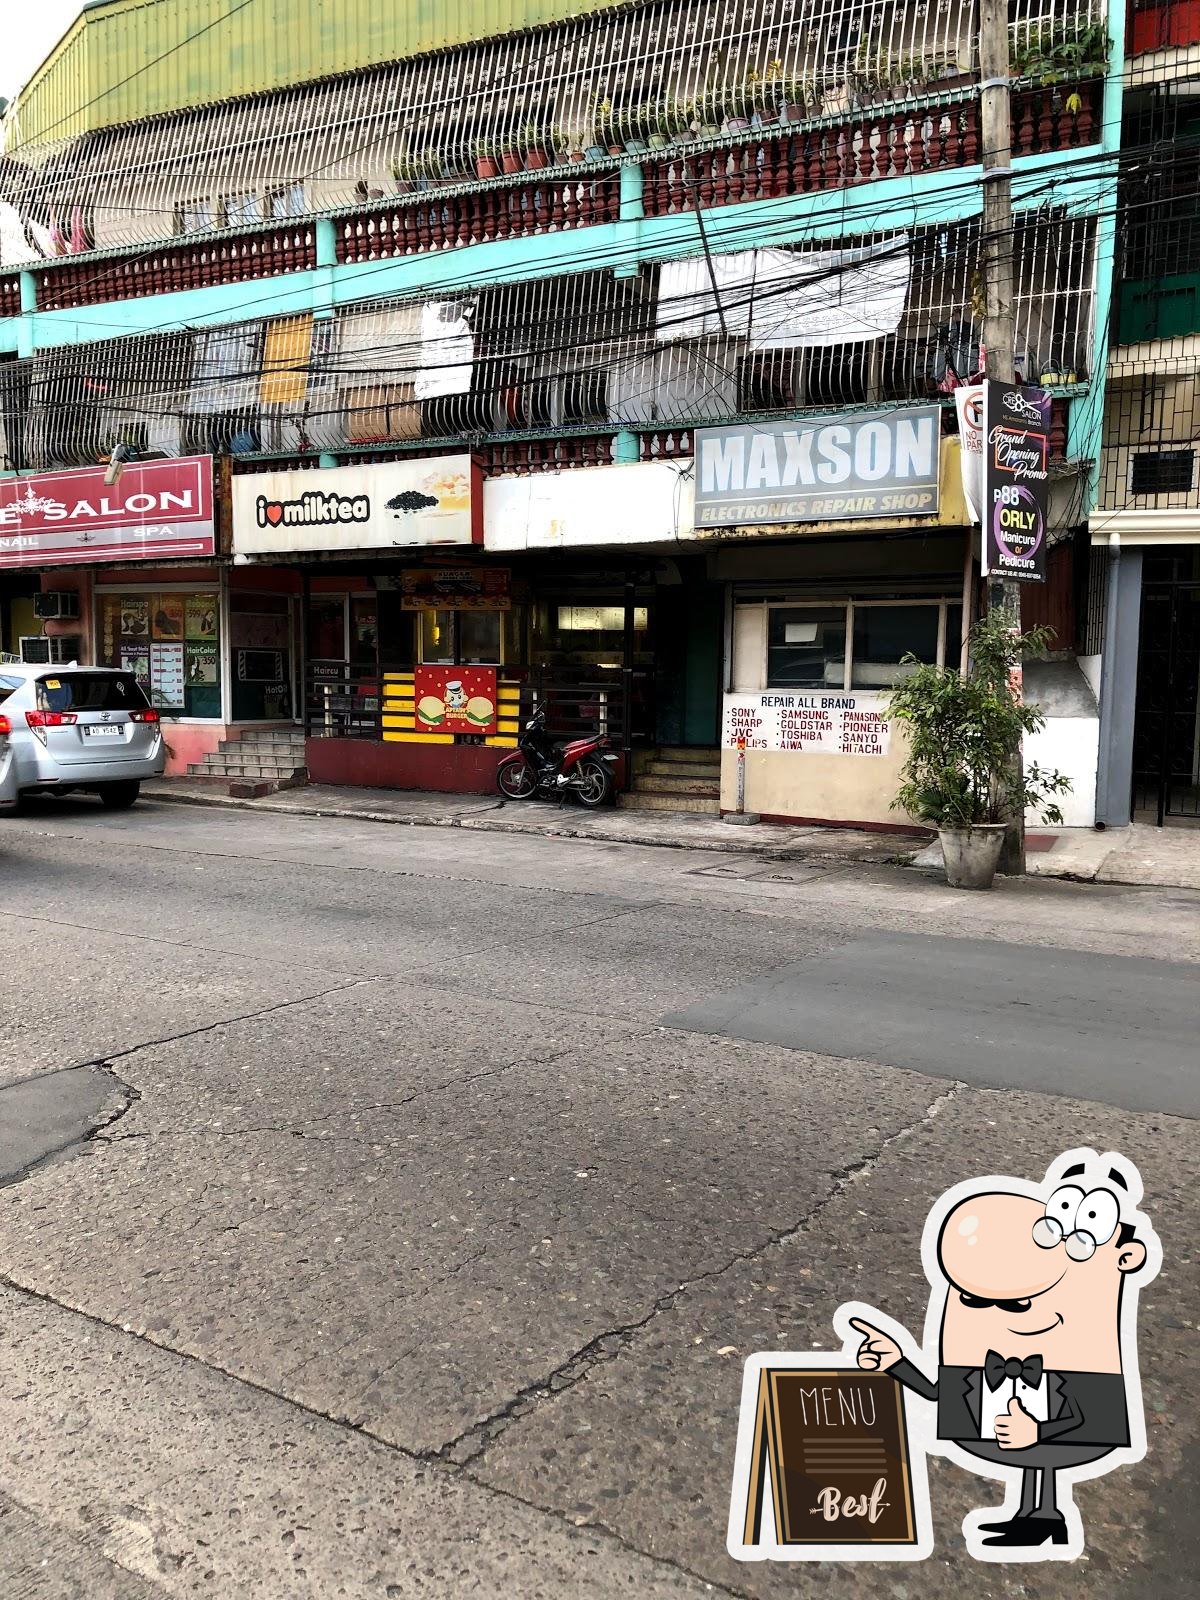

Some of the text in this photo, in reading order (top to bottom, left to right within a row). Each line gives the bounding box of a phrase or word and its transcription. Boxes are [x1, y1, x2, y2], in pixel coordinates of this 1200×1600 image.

[1021, 409, 1042, 420] SALON
[965, 431, 977, 441] NO
[988, 424, 1027, 446] Grand
[702, 417, 933, 493] MAXSON
[996, 443, 1040, 467] Opening
[1012, 460, 1048, 482] Promo
[43, 489, 193, 521] SALON
[283, 493, 369, 525] milktea
[701, 493, 933, 522] ELECTRONICS REPAIR SHOP
[1000, 508, 1035, 530] ORLY
[133, 525, 174, 537] SPA
[1000, 531, 1036, 545] Manicure
[1014, 546, 1022, 554] or
[999, 554, 1036, 569] Pedicure
[186, 646, 217, 654] HairColor
[761, 696, 856, 710] REPAIR ALL BRAND
[731, 708, 756, 718] SONY
[781, 710, 829, 720] SAMSUNG
[731, 718, 762, 728] SHARP
[781, 720, 832, 731] GOLDSTAR
[843, 722, 888, 733] PIONEER
[731, 728, 753, 738] JVC
[781, 731, 822, 741] TOSHIBA
[843, 732, 878, 744] SANYO
[780, 741, 802, 750] AIWA
[842, 744, 882, 755] HITACHI
